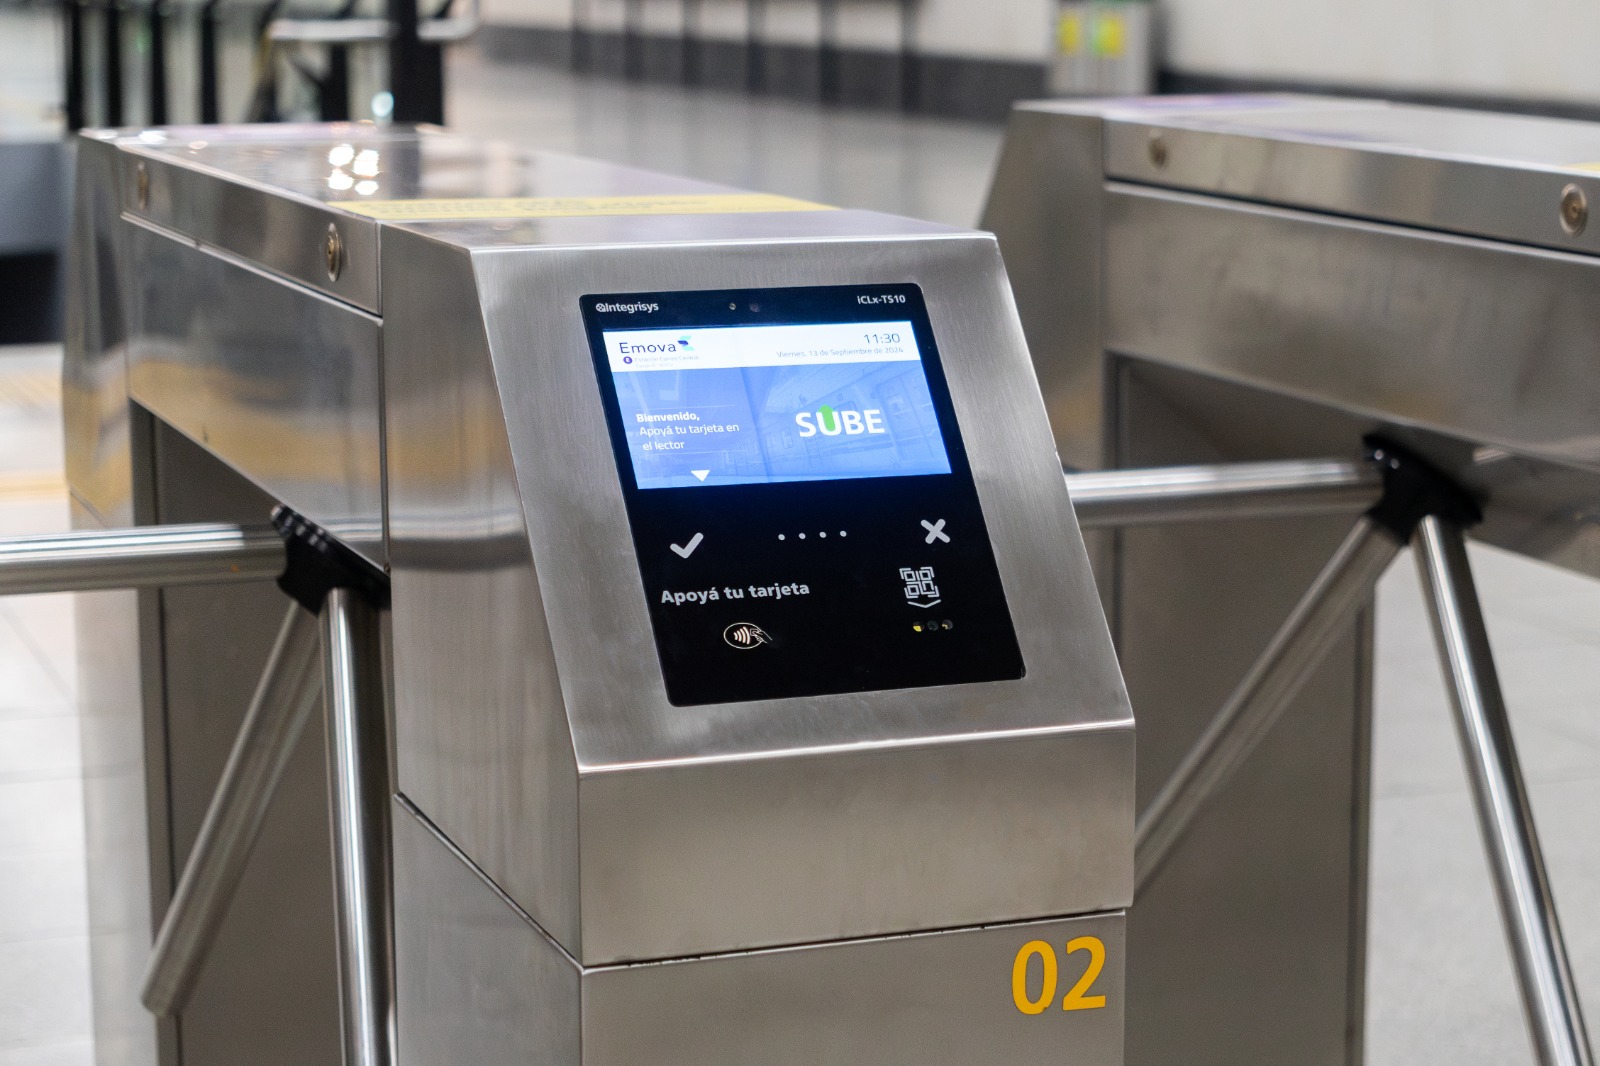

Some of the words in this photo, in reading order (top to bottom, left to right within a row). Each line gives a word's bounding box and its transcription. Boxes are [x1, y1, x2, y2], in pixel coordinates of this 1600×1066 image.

[857, 294, 906, 305] iCLx-TS10
[605, 301, 659, 313] Integrisys
[863, 333, 901, 344] 11:30
[619, 342, 676, 354] Emova
[809, 349, 818, 357] 13
[820, 347, 829, 356] de
[831, 346, 872, 356] Septiembre
[874, 346, 883, 354] de
[636, 412, 700, 422] Bienvenido,
[795, 409, 885, 437] SUBE
[640, 426, 673, 438] Apoyá
[675, 426, 687, 435] tu
[689, 424, 724, 435] tarjeta
[726, 424, 740, 432] en
[642, 441, 653, 451] el
[655, 441, 685, 450] lector
[661, 587, 720, 606] Apoyá
[723, 587, 744, 599] tu
[748, 582, 810, 599] tarjeta
[1012, 936, 1106, 1015] 02
